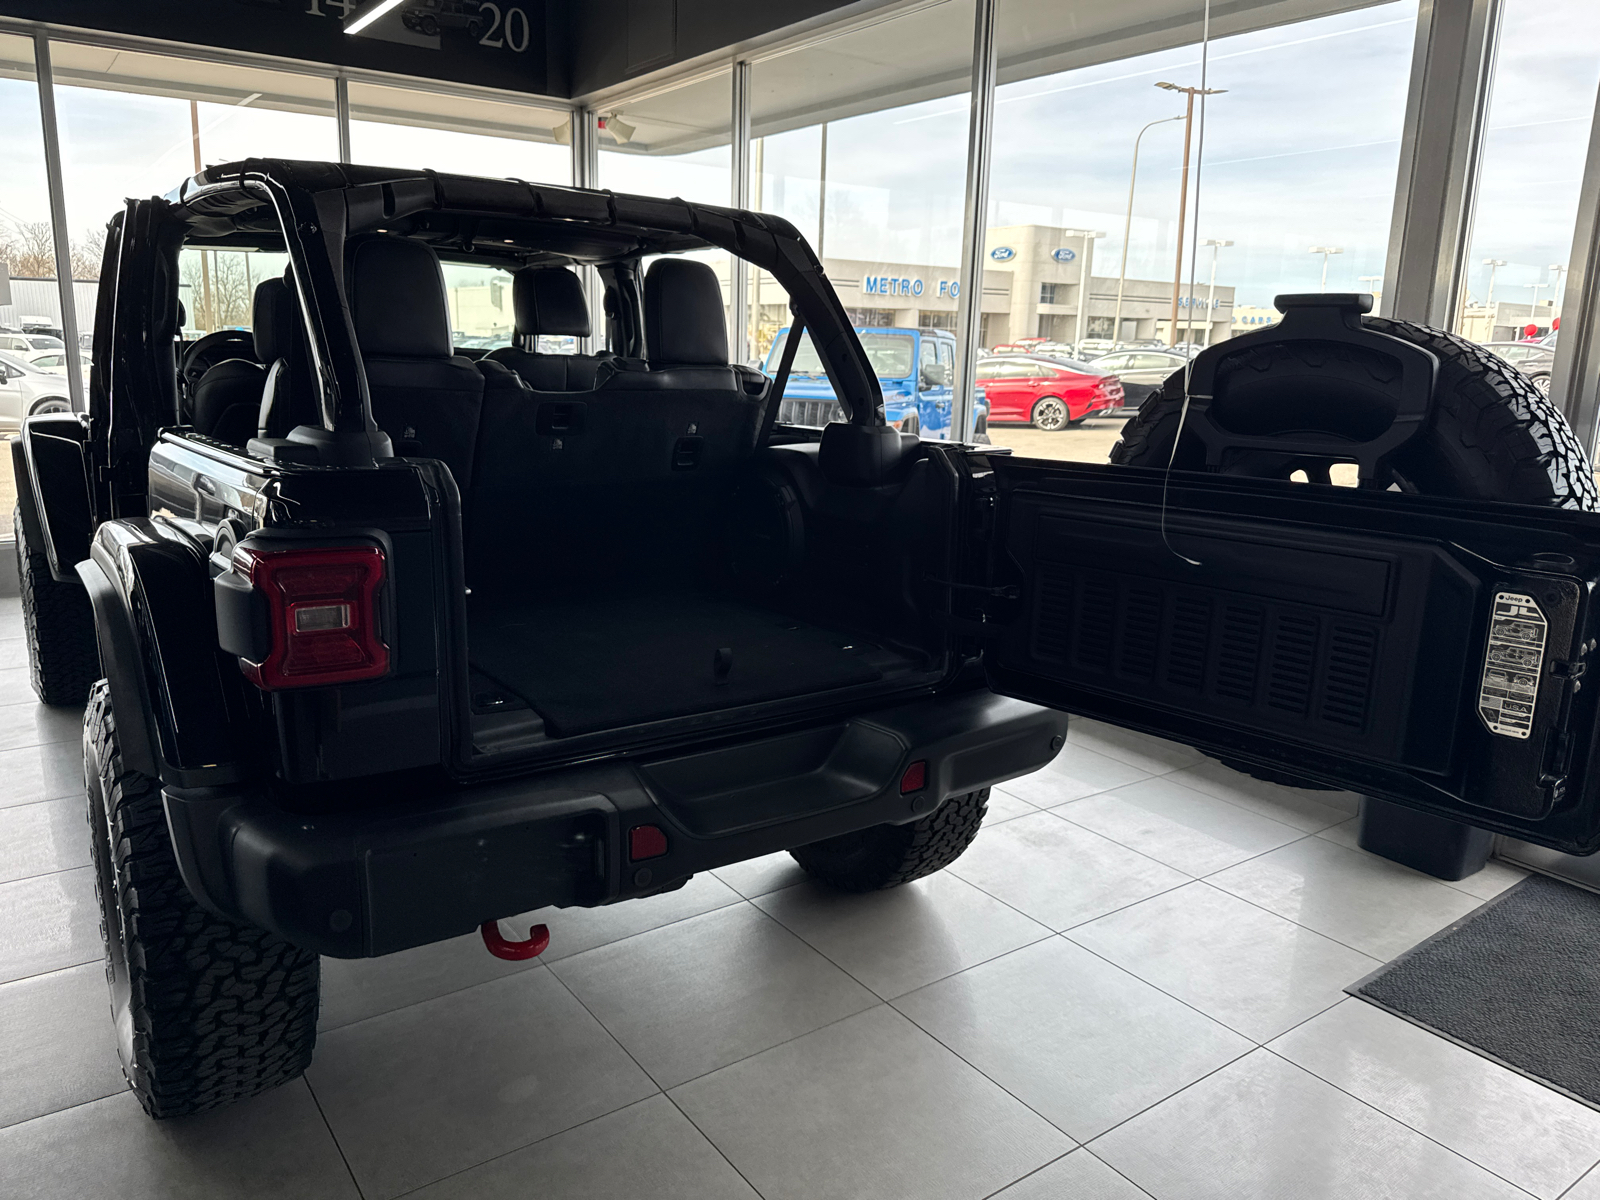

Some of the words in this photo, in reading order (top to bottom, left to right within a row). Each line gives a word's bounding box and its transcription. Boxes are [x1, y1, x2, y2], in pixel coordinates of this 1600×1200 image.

[478, 2, 530, 53] 20
[993, 249, 1010, 259] Ford
[864, 276, 924, 296] METRO
[937, 280, 960, 298] FO
[1178, 297, 1220, 308] SERVIE
[1241, 316, 1272, 324] CARS
[1505, 595, 1523, 603] Jeep
